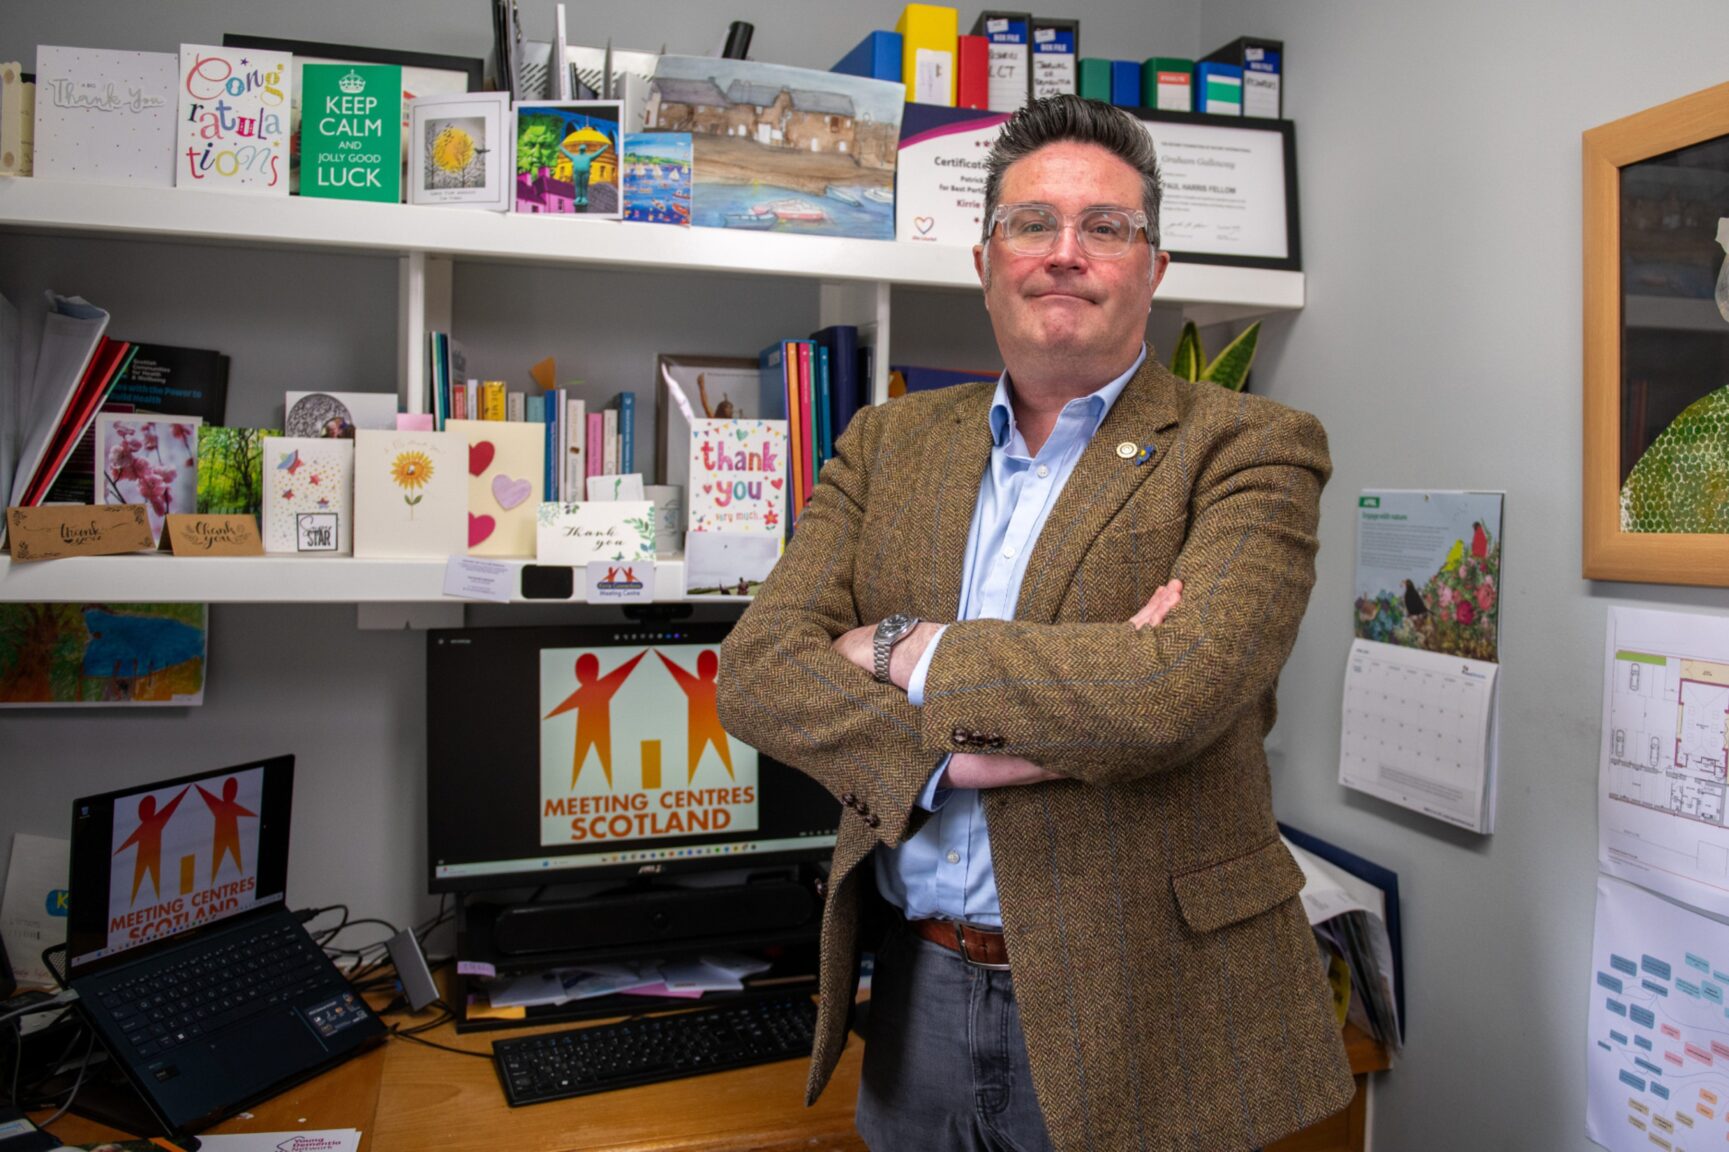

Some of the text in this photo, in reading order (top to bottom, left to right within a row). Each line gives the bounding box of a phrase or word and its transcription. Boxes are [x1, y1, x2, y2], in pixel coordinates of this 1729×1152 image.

[187, 53, 284, 107] Cong
[326, 96, 378, 115] KEEP
[188, 100, 282, 140] ratula
[319, 118, 382, 137] CALM
[338, 141, 362, 150] AND
[186, 142, 280, 187] tions
[318, 153, 381, 164] JOLLY GOOD
[317, 167, 382, 187] LUCK
[701, 440, 778, 472] thank
[714, 480, 763, 507] you
[715, 512, 733, 523] very
[307, 530, 331, 546] STAR
[563, 526, 617, 538] Thank
[544, 786, 755, 817] MEETING CENTRES
[571, 808, 731, 841] SCOTLAND
[111, 876, 255, 933] MEETING CENTRES
